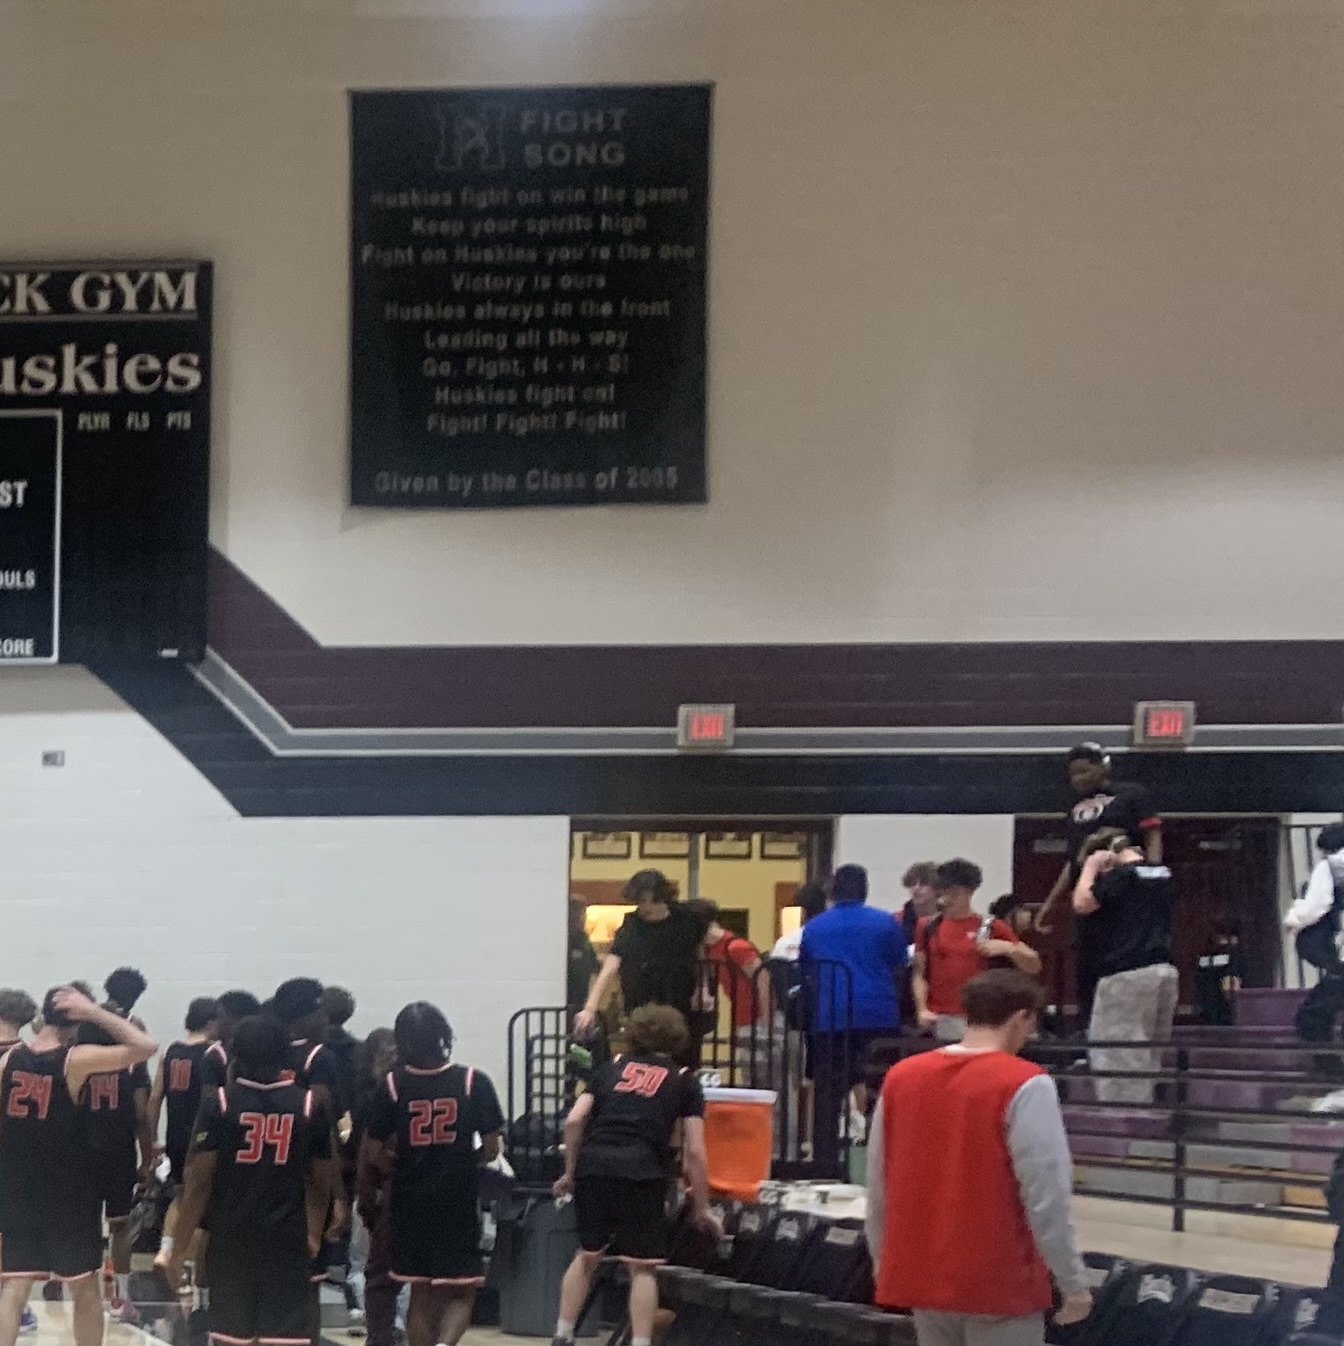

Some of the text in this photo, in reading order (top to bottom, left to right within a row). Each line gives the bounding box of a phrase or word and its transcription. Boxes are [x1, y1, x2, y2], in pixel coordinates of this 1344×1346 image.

[520, 108, 628, 135] FIGHT
[524, 141, 626, 168] SONG
[461, 184, 510, 209] fight
[517, 187, 542, 205] on
[551, 185, 586, 203] win
[594, 184, 626, 203] the
[634, 186, 689, 207] game
[411, 213, 648, 239] Keep your spirits high
[361, 244, 415, 268] Fight
[421, 247, 448, 264] on
[454, 244, 538, 264] Huskies
[618, 243, 652, 261] the
[657, 246, 696, 260] one
[70, 270, 198, 315] GYM
[451, 272, 607, 294] Victory is ours
[383, 297, 671, 324] Huskies always in the front
[423, 327, 629, 351] Leading all the way
[434, 383, 518, 405] Huskies
[524, 382, 575, 408] fight
[374, 470, 440, 493] Given
[448, 471, 474, 498] by
[481, 471, 517, 492] the
[525, 468, 587, 491] Class
[594, 466, 620, 491] of
[614, 1060, 670, 1099] 50
[408, 1097, 459, 1146] 22
[235, 1111, 295, 1166] 34
